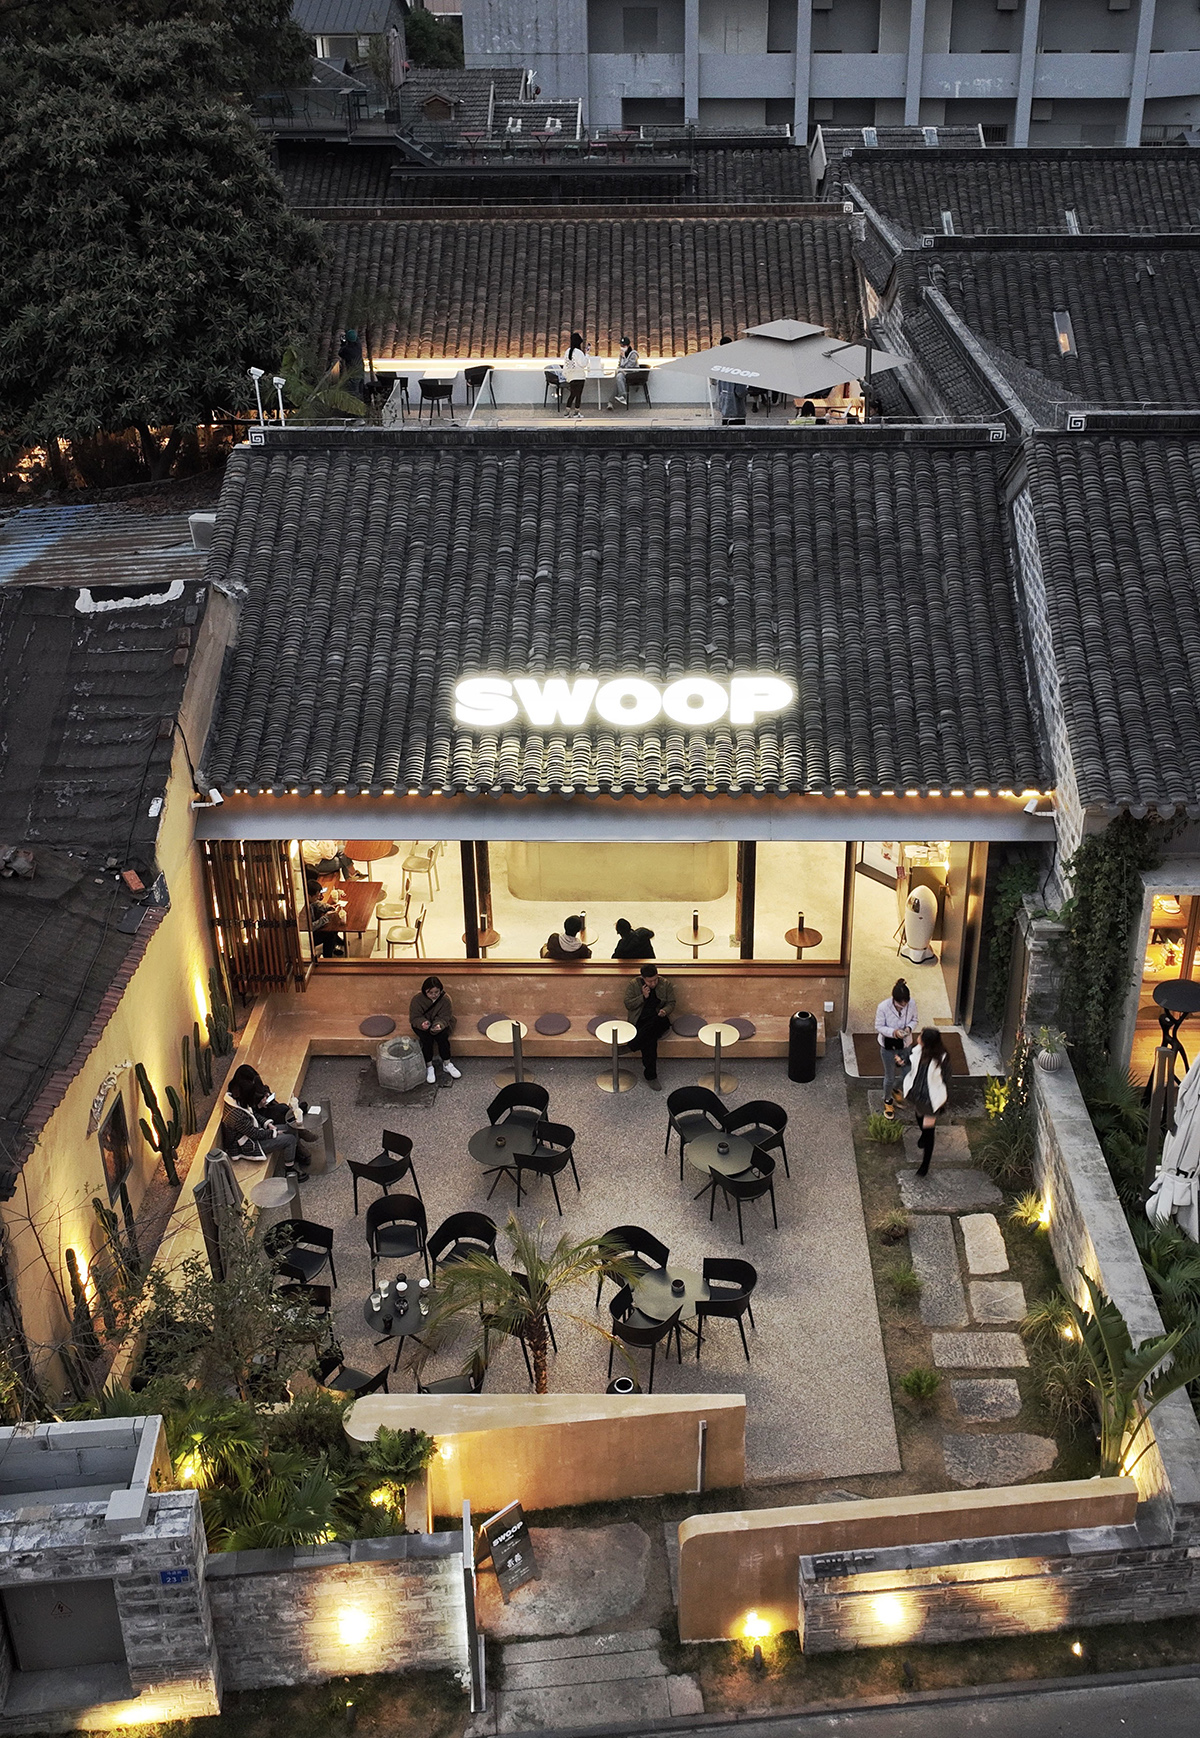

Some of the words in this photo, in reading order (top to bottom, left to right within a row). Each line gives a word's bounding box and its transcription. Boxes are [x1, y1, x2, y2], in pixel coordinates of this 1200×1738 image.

[710, 365, 760, 378] SWOOP
[454, 676, 795, 726] SWOOP
[492, 1521, 524, 1547] SWOOP
